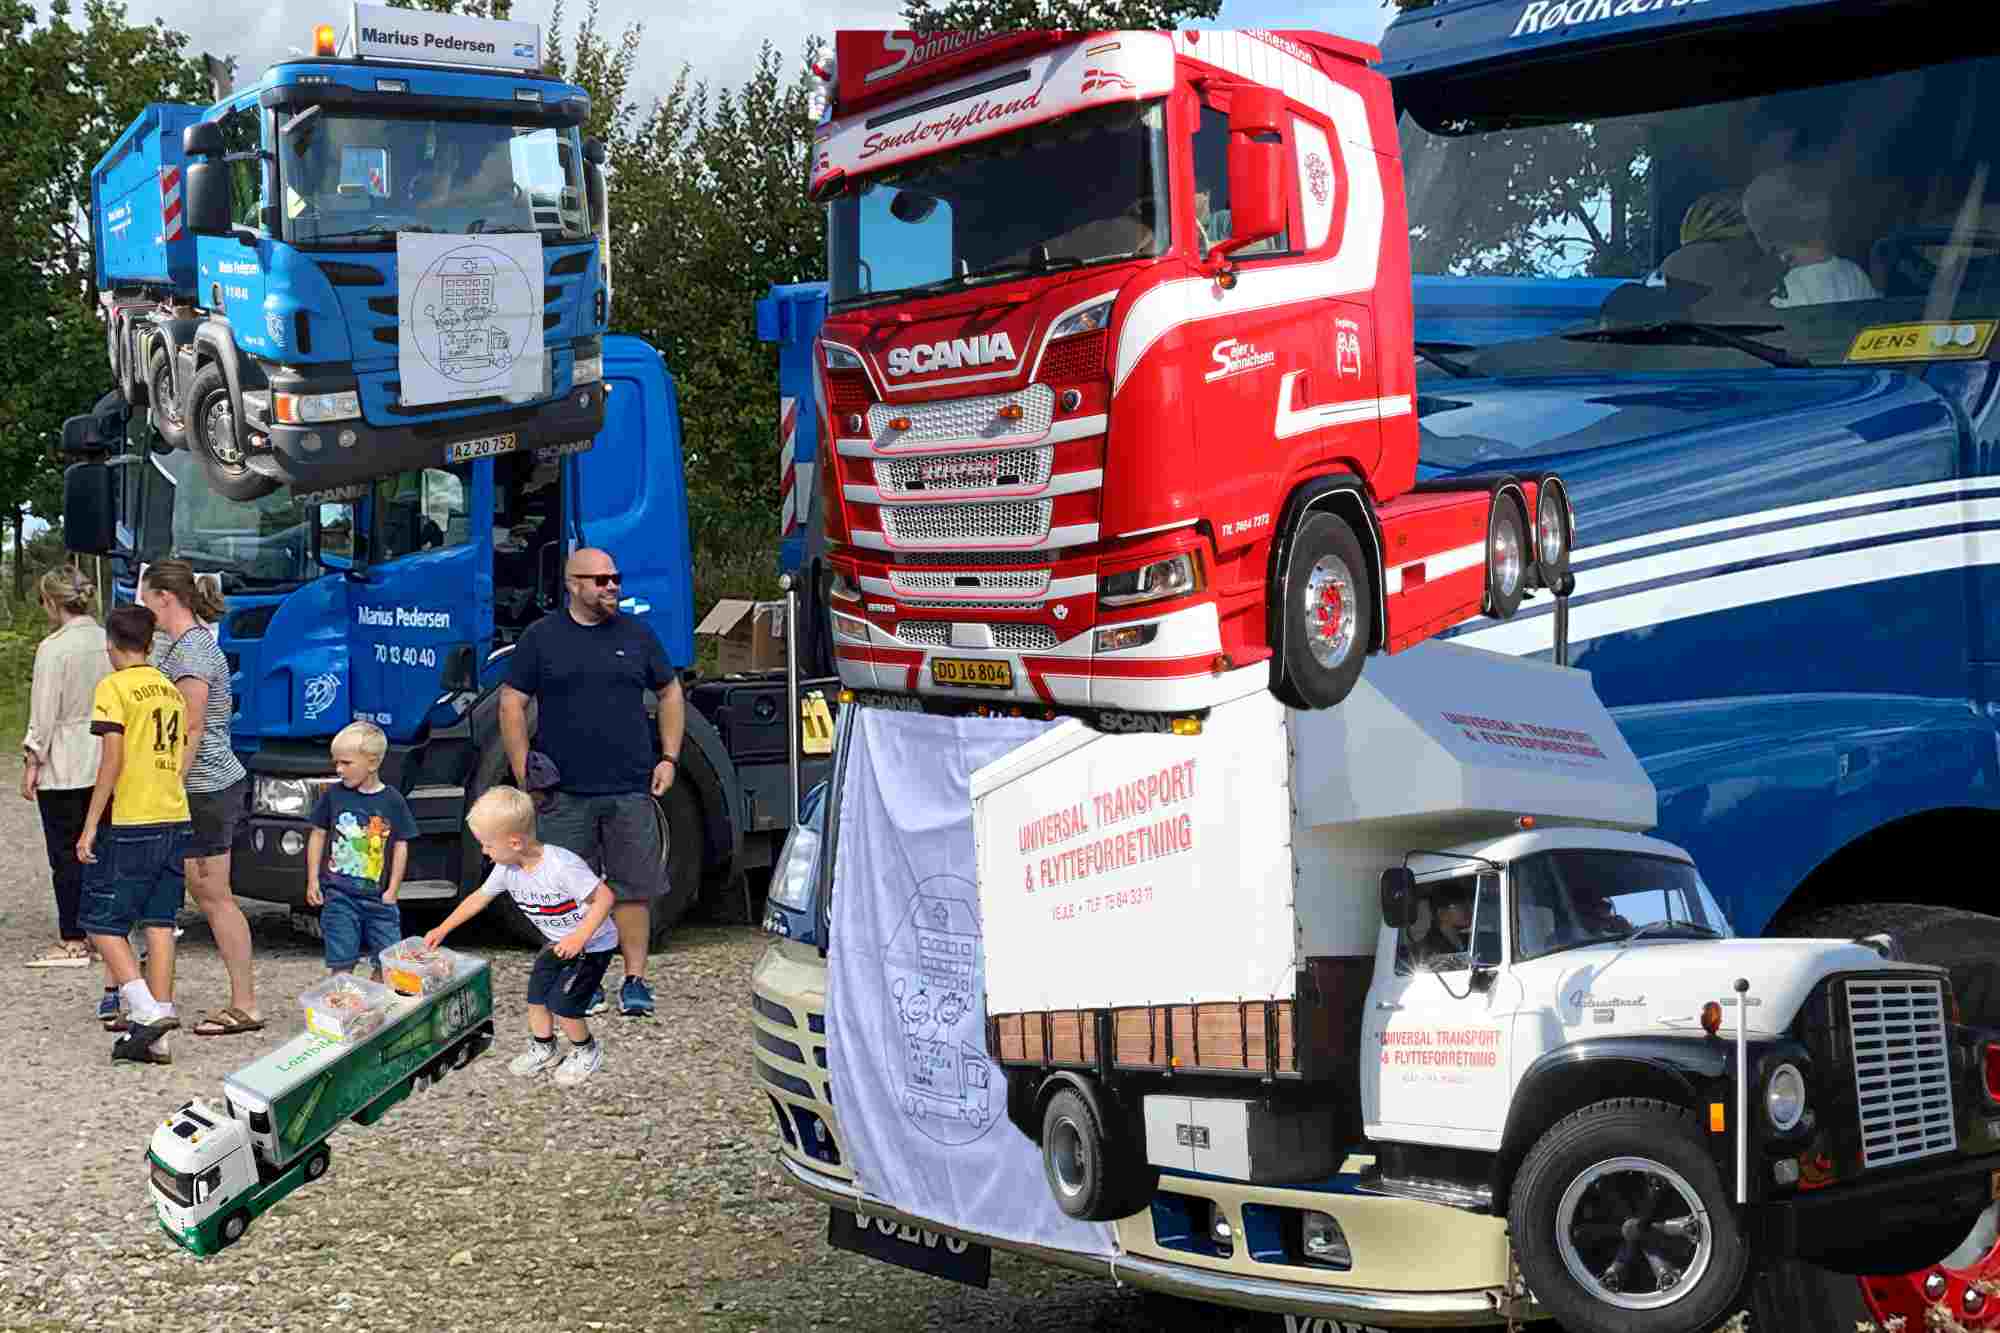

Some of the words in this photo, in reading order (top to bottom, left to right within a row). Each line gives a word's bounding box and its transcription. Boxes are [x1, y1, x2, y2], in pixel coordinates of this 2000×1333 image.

[362, 27, 418, 47] Marius
[424, 33, 495, 54] Pedersen
[1860, 335, 1918, 350] JENS
[888, 332, 1016, 377] SCANIA
[453, 443, 472, 458] AZ
[474, 440, 490, 455] 20
[492, 435, 515, 452] 752
[358, 606, 393, 626] Marius
[396, 607, 450, 628] Pedersen
[373, 644, 387, 662] 70
[389, 645, 401, 665] 13
[402, 647, 417, 666] 40
[419, 648, 436, 668] 40
[936, 662, 957, 679] DD
[959, 662, 976, 681] 16
[978, 663, 1005, 683] 804
[152, 707, 178, 757] 14
[1100, 711, 1168, 732] SCAN
[1017, 803, 1088, 854] UNIVERSAL
[1093, 758, 1197, 828] TRANSPORT
[1025, 863, 1034, 892] &
[1040, 813, 1192, 888] FLYTTEFORRETNING
[1380, 1031, 1433, 1046] UNIVERSAL
[1437, 1030, 1500, 1046] TRANSPORT
[1394, 1050, 1496, 1067] FLYTTEFORRETNING
